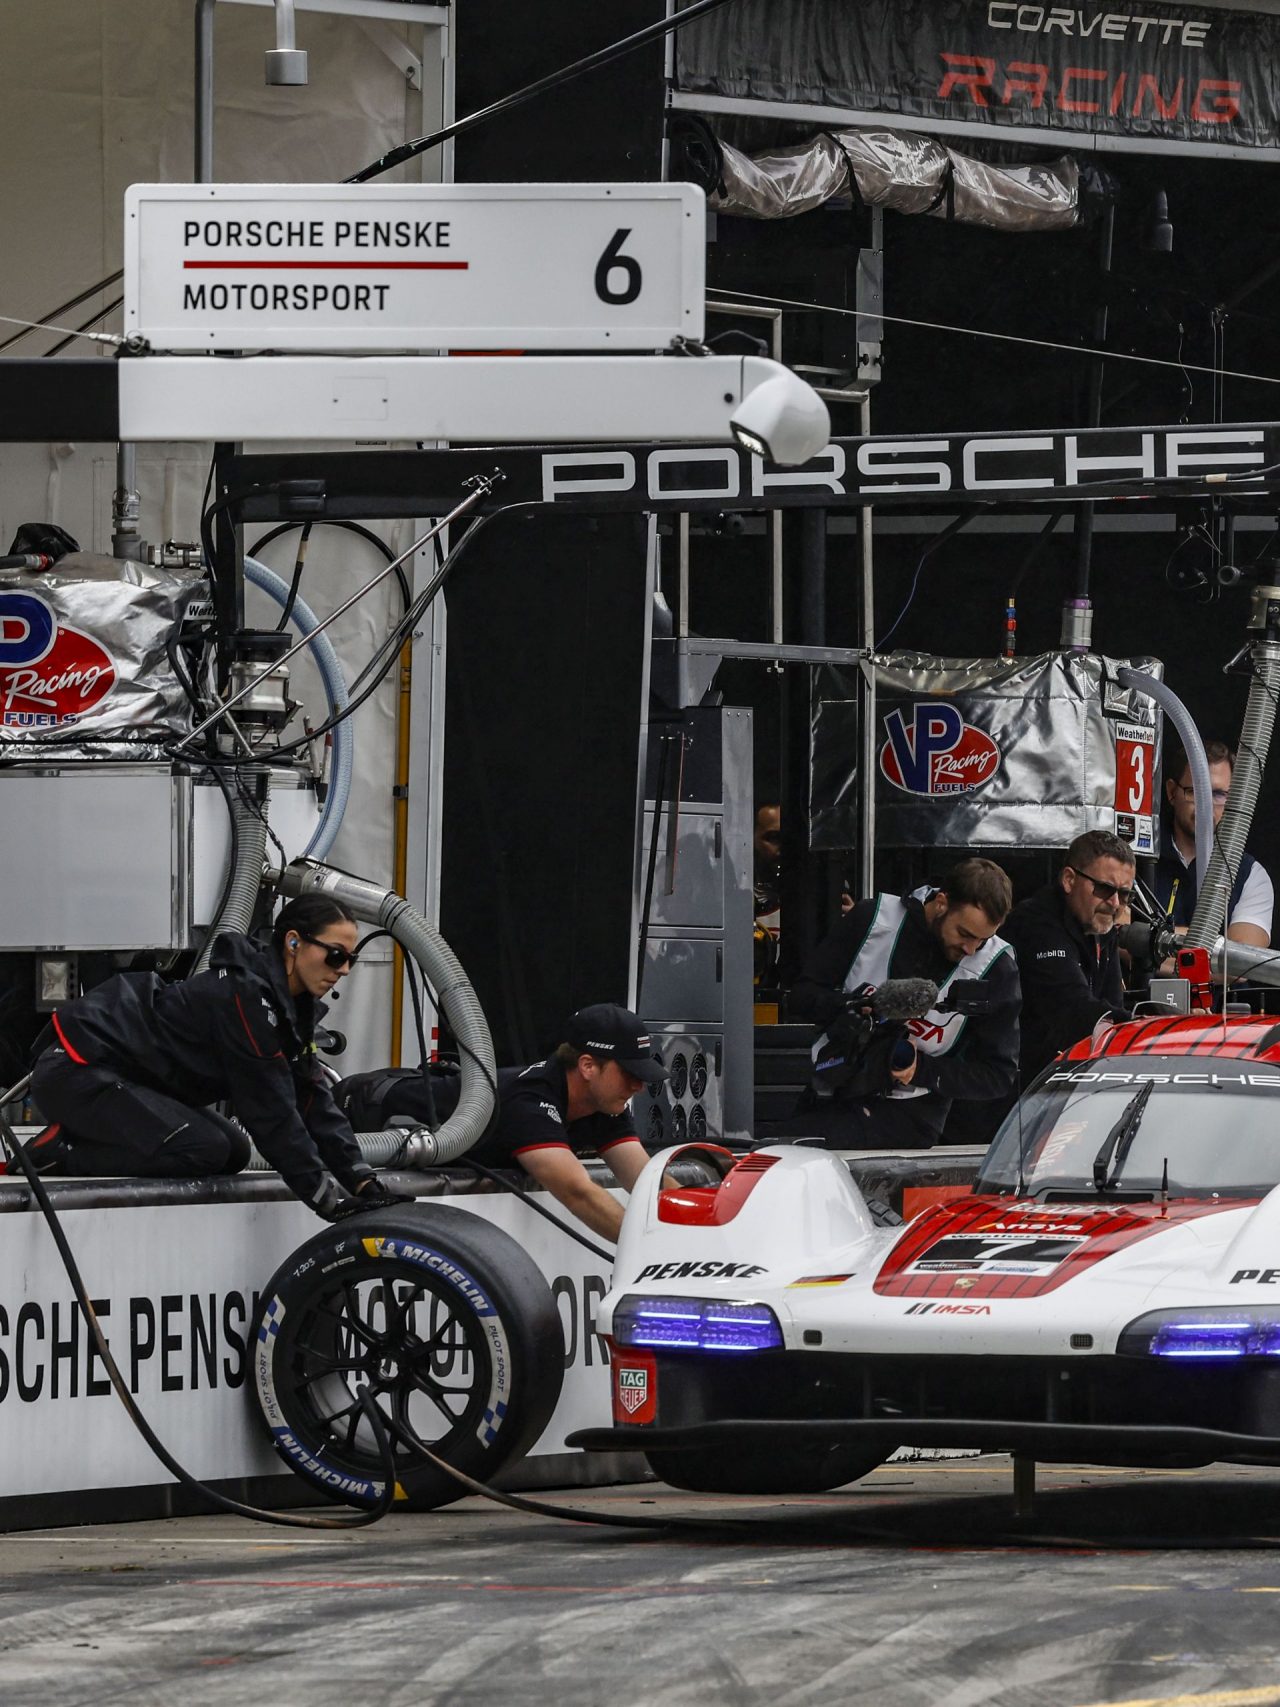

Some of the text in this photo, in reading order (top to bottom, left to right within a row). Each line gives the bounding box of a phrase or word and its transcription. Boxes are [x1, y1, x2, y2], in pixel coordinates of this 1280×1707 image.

[987, 2, 1212, 48] CORVETTE
[938, 53, 1241, 124] RACING
[183, 221, 451, 249] PORSCHE PENSKE
[593, 228, 643, 306] 6
[183, 284, 390, 312] MOTORSPORT
[541, 431, 1265, 502] PORSCHE
[5, 662, 114, 710] Racing
[4, 712, 78, 727] FUELS
[884, 702, 964, 796] VP
[933, 749, 999, 783] Racing
[933, 782, 976, 793] FUELS
[1128, 745, 1145, 812] 3
[977, 1222, 1083, 1232] Ansys
[974, 1239, 1037, 1260] 7
[401, 1245, 489, 1311] MICHELIN
[632, 1261, 770, 1285] PENSKE
[621, 1372, 644, 1386] TAG
[620, 1389, 645, 1410] HEUER
[280, 1432, 368, 1497] MICHELIN
